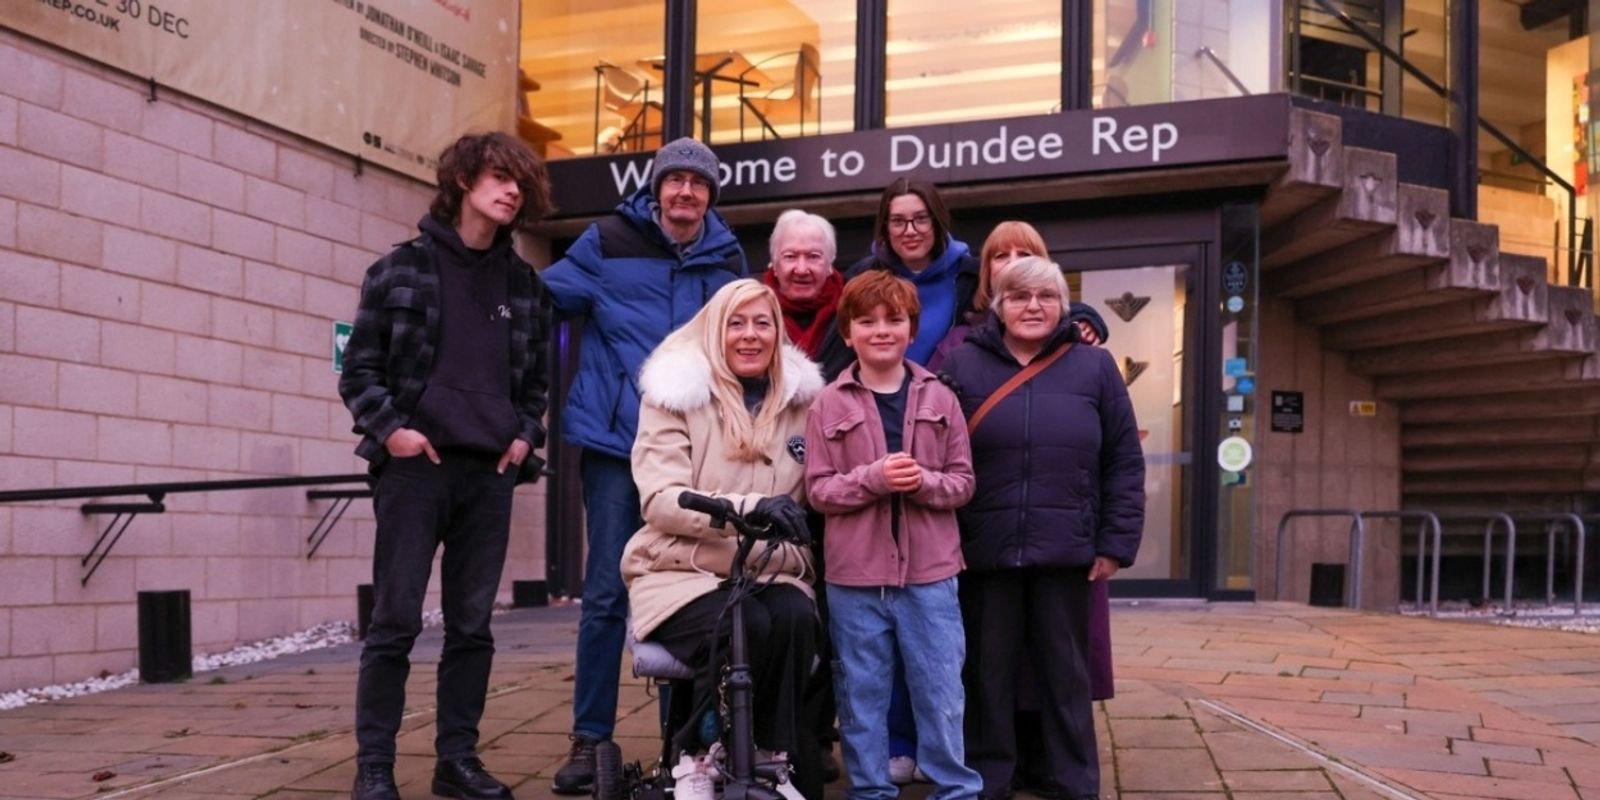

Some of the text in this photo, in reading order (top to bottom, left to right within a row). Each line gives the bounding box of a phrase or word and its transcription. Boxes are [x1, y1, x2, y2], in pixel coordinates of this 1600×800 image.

[115, 0, 189, 39] 30 DEC
[365, 5, 405, 37] JONATHAN
[396, 43, 428, 71] STEPHEN
[610, 116, 1179, 196] Wome to Dundee Rep
